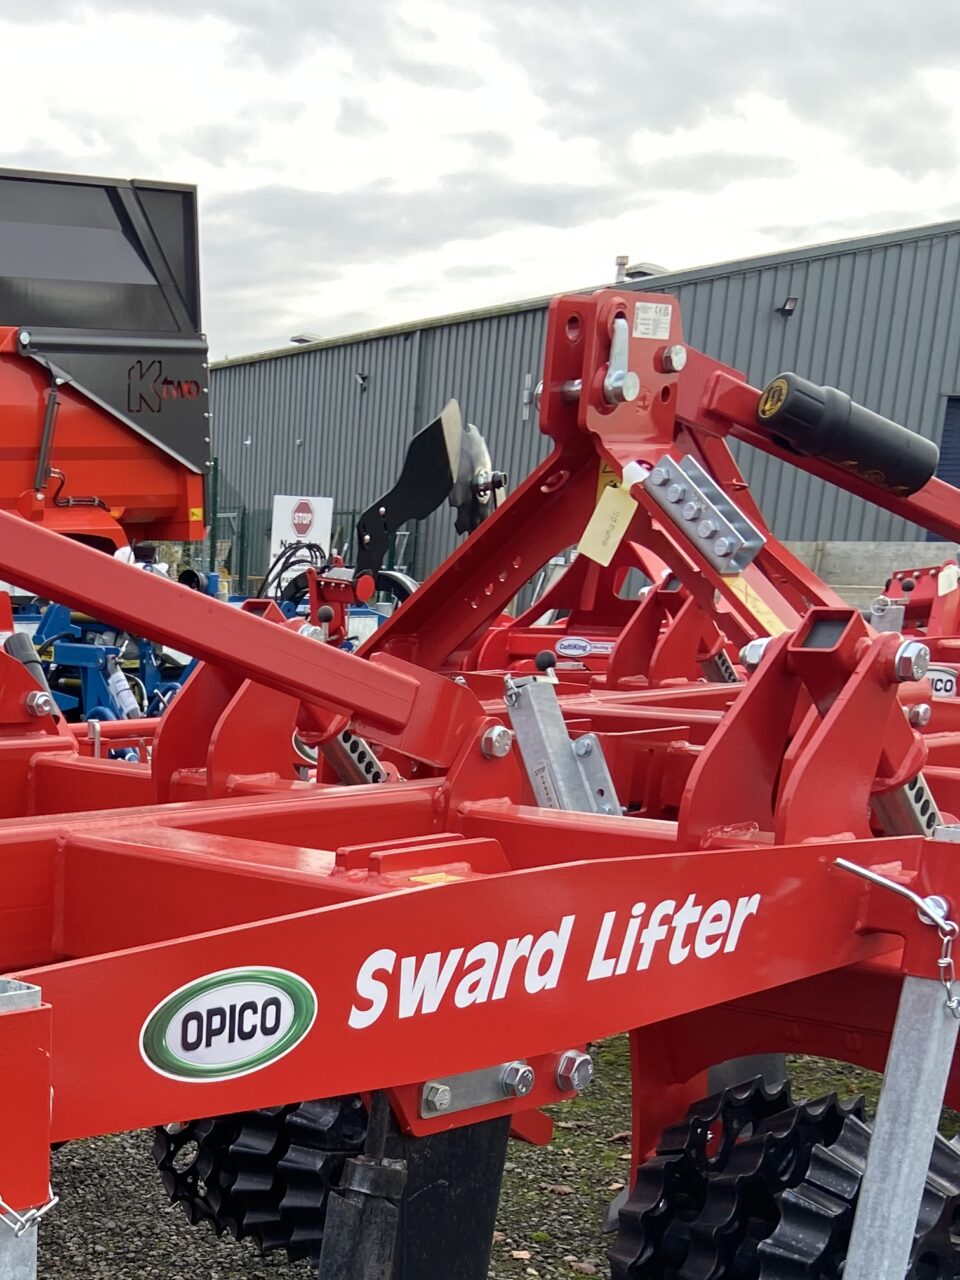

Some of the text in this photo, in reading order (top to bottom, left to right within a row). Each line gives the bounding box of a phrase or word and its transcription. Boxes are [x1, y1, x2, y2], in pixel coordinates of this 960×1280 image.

[294, 512, 312, 524] STOP
[347, 893, 761, 1029] Sward Lifter
[180, 996, 282, 1052] OPICO
